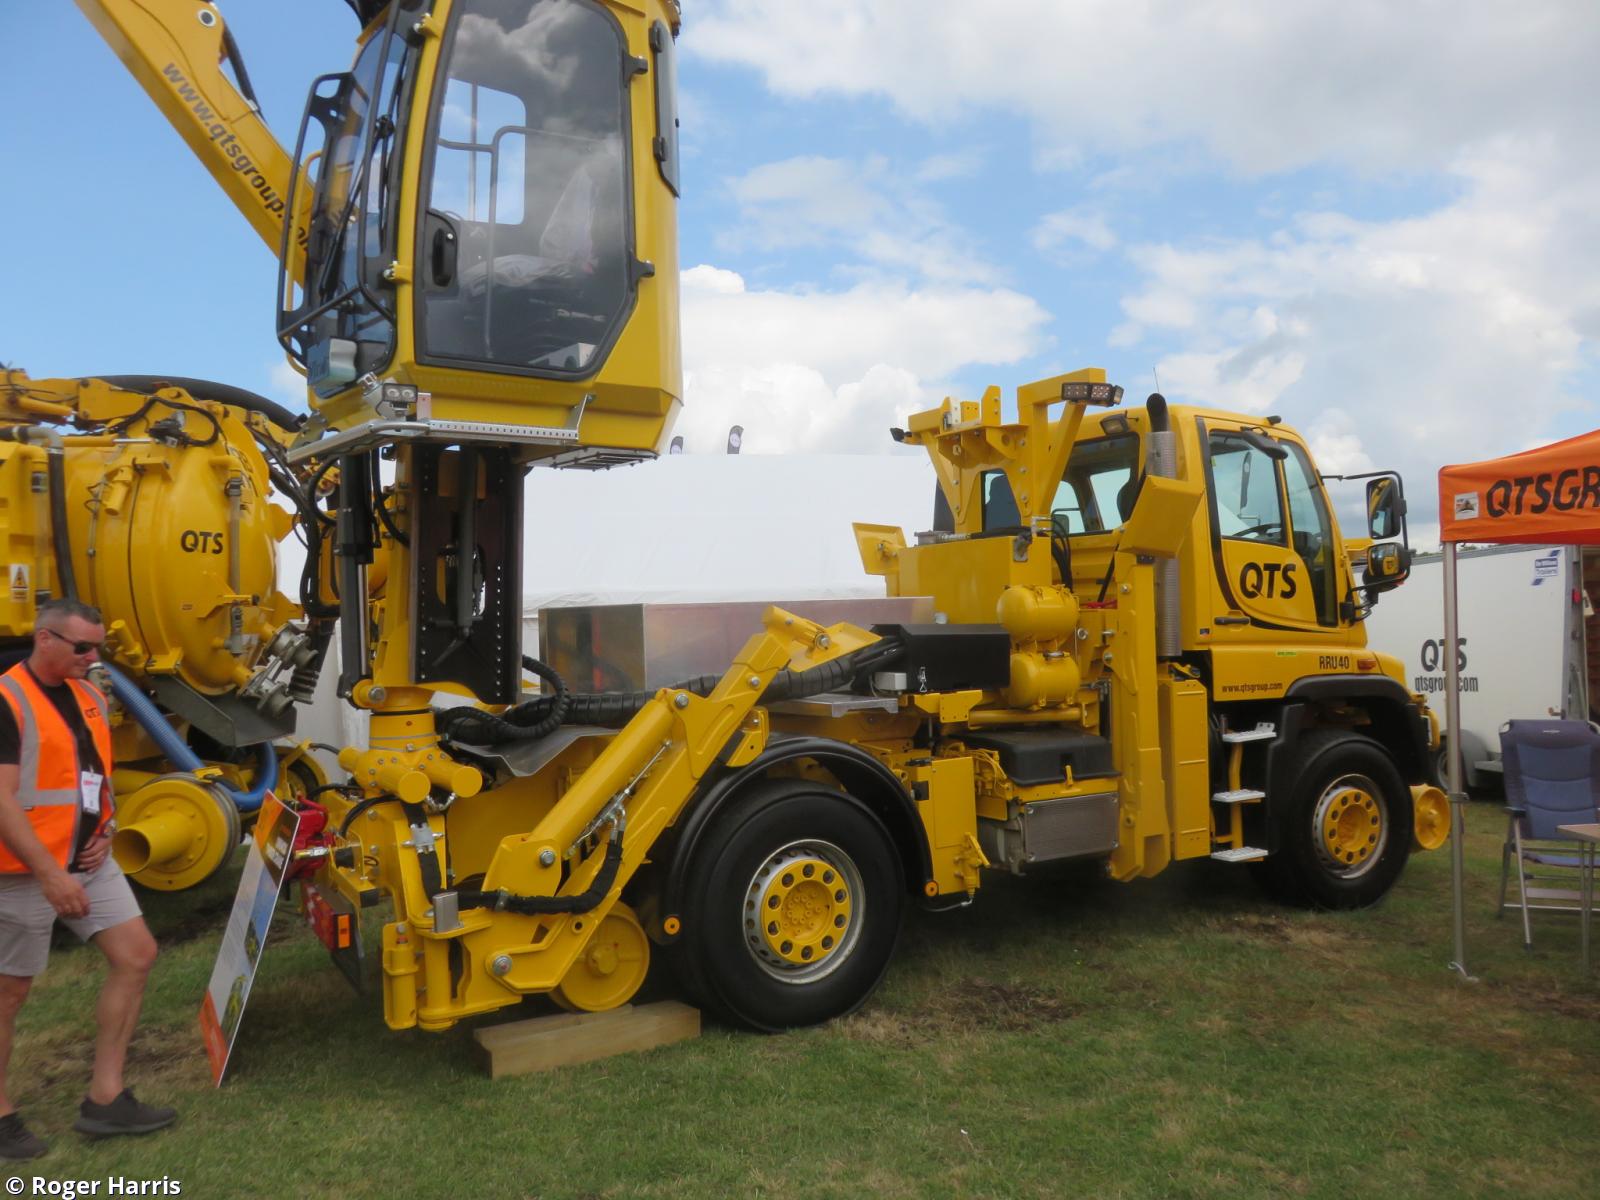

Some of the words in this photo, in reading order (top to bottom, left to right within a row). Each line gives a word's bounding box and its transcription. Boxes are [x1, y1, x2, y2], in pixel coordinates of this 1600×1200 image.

[181, 529, 224, 555] QTS
[1240, 562, 1297, 599] QTS
[1221, 681, 1283, 694] www.qtsgroup.com
